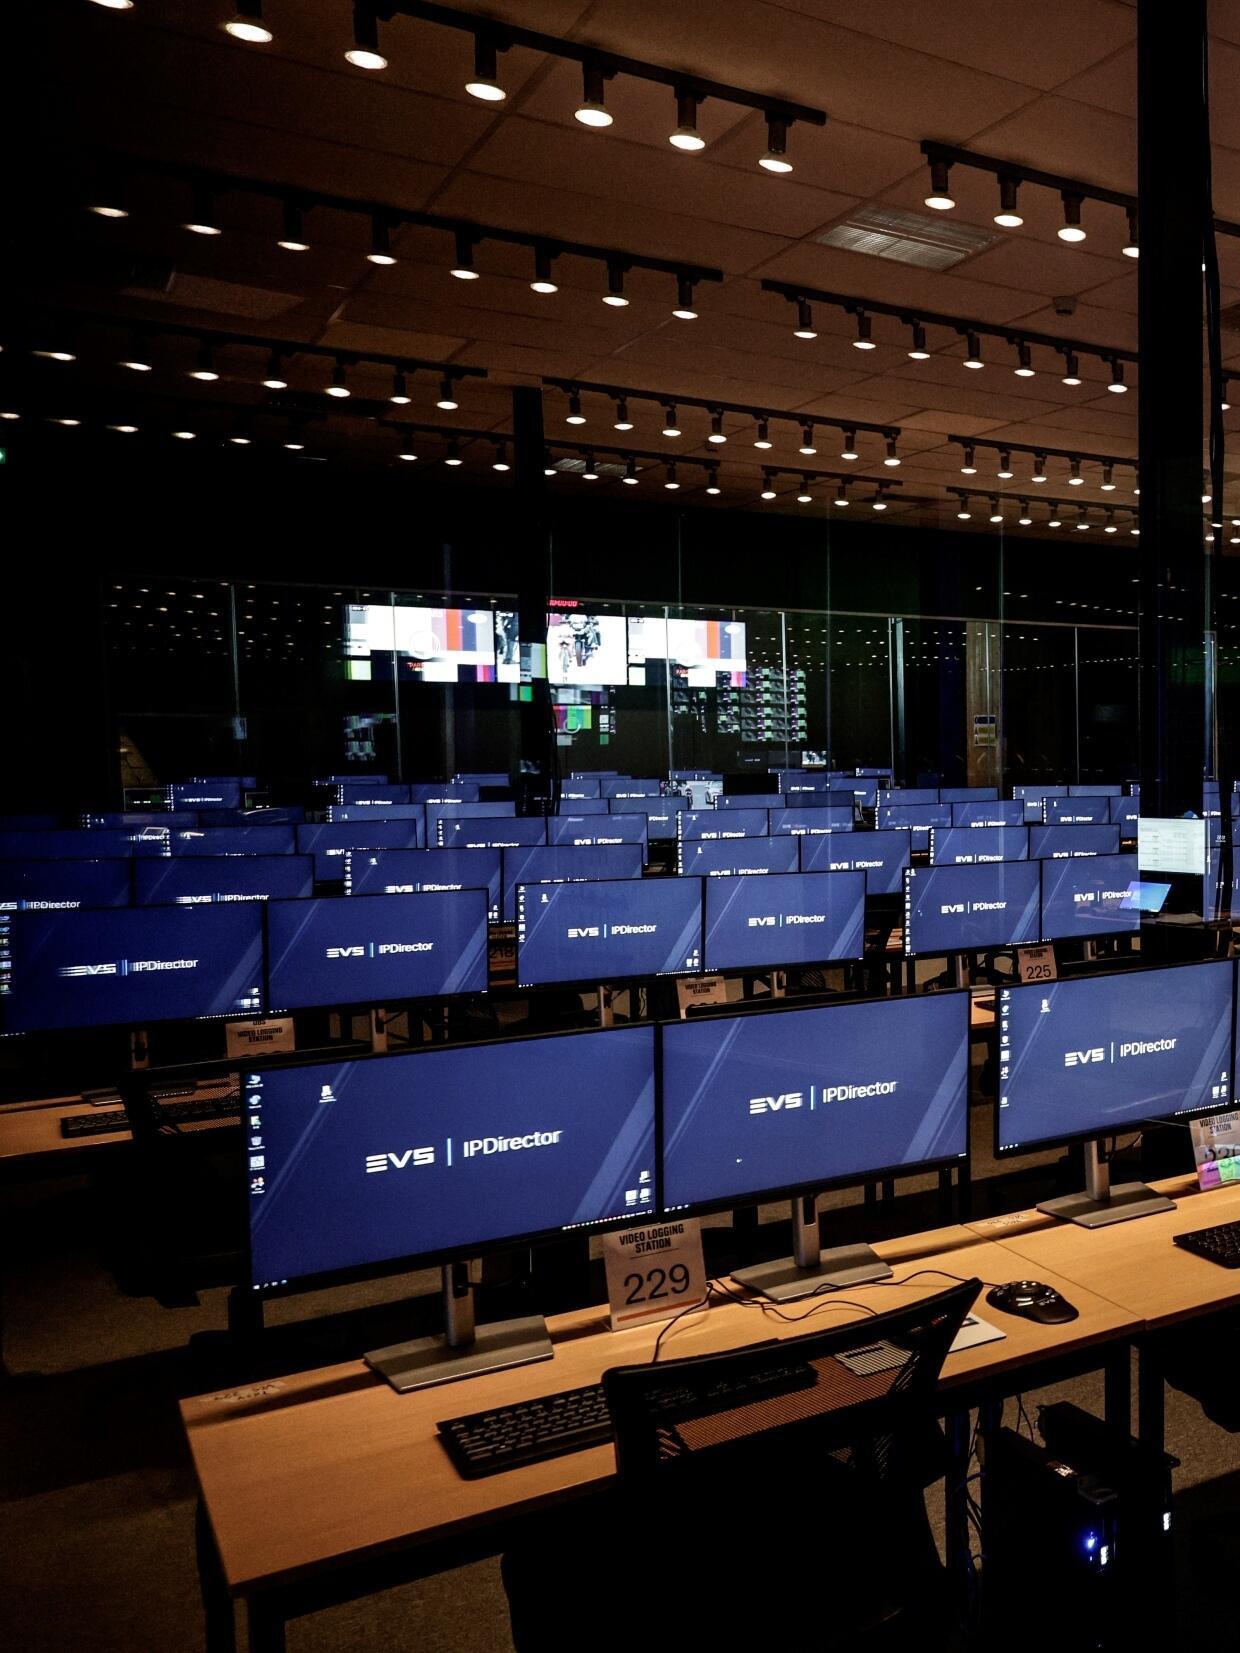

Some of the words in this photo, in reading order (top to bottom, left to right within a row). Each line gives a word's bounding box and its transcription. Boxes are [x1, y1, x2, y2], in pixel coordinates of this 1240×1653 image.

[830, 862, 849, 870] EVS
[385, 885, 413, 893] EVS
[1074, 893, 1094, 901] EVS
[1102, 889, 1132, 900] IPDirector
[27, 901, 80, 909] IPDirector
[941, 904, 964, 913] EVS
[973, 902, 1006, 910] IPDirector
[749, 917, 775, 926] EVS
[786, 915, 825, 924] IPDirector
[568, 927, 599, 937] EVS
[612, 925, 656, 934] IPDirector
[327, 947, 364, 957] EVS
[379, 943, 433, 953] IPDirector
[64, 964, 116, 976] EVS
[133, 960, 198, 971] IPDirector
[1026, 965, 1051, 979] 225
[1065, 1048, 1104, 1066] EVS
[1120, 1039, 1176, 1057] IPDirector
[750, 1093, 802, 1114] EVS
[823, 1082, 897, 1103] IPDirector
[1200, 1117, 1215, 1128] VIDEO
[1216, 1113, 1238, 1124] LOGGING
[1210, 1123, 1232, 1134] STATION
[366, 1147, 434, 1173] EVS
[464, 1131, 562, 1157] IPDirector
[619, 1231, 645, 1245] VIDEO
[648, 1224, 684, 1240] LOGGING
[635, 1238, 671, 1253] STATION
[624, 1264, 690, 1305] 229
